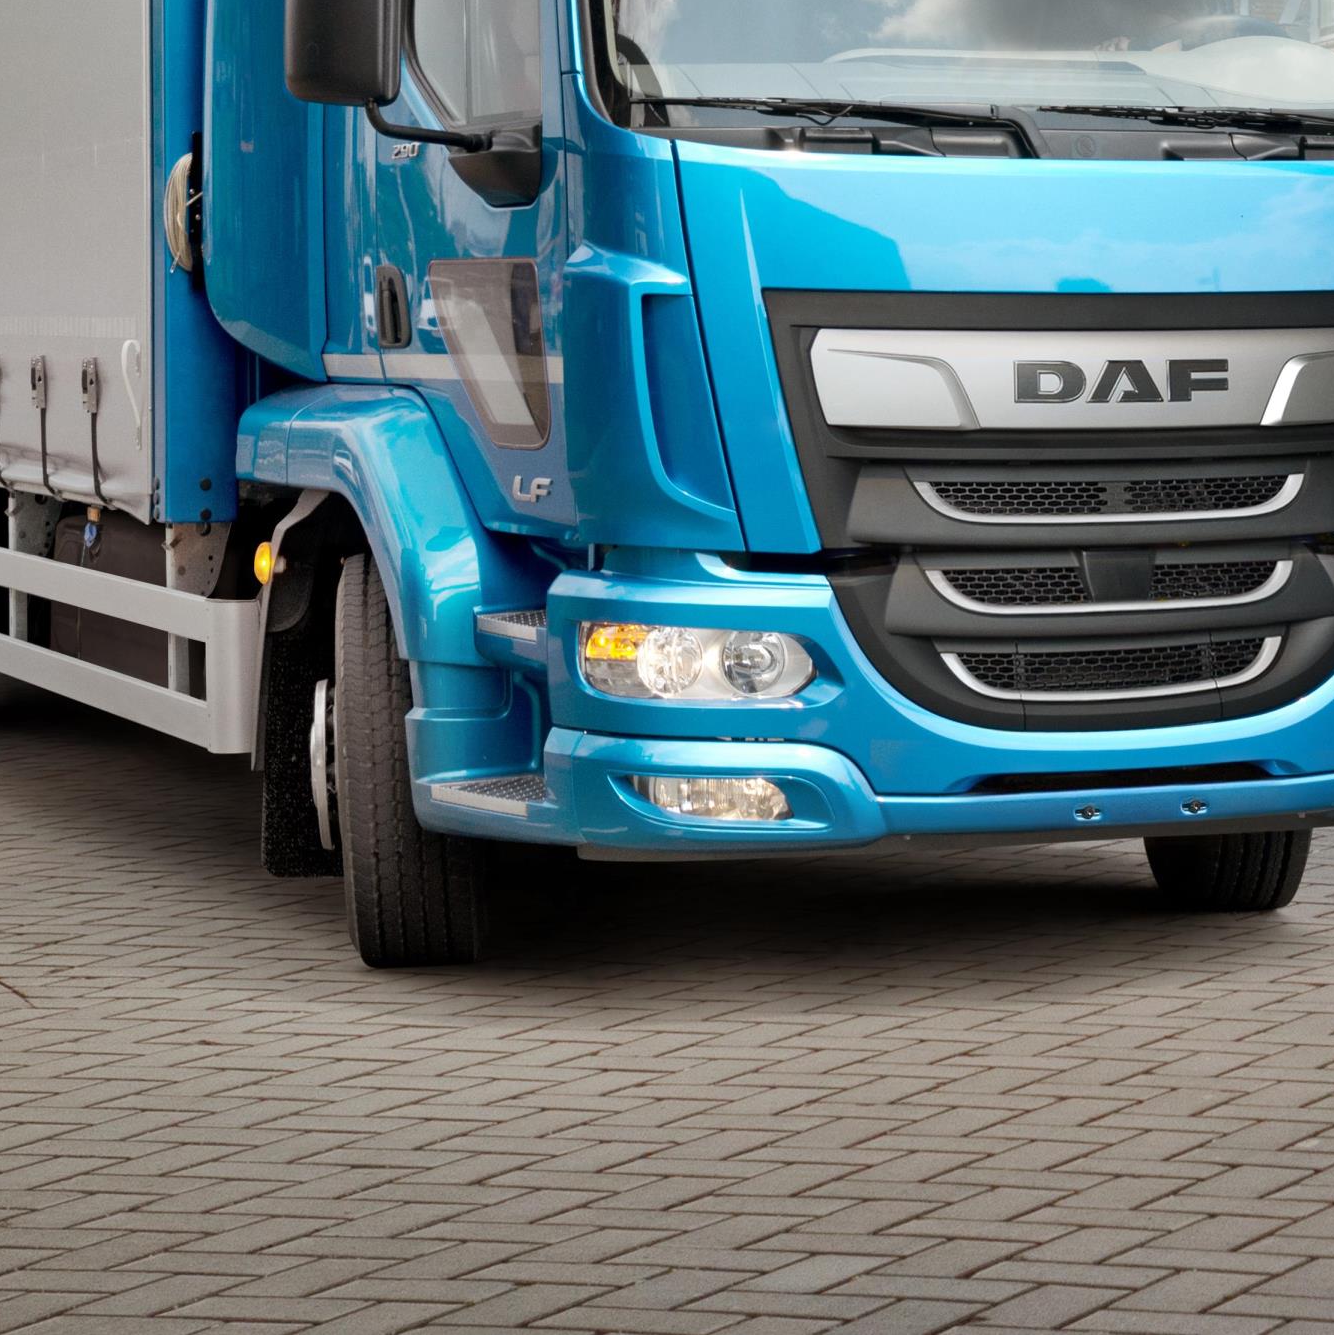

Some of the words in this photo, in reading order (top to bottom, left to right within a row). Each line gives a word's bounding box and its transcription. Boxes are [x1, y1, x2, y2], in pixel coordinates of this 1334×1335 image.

[393, 142, 420, 158] 290
[1013, 359, 1229, 403] DAF
[513, 475, 552, 502] LF
